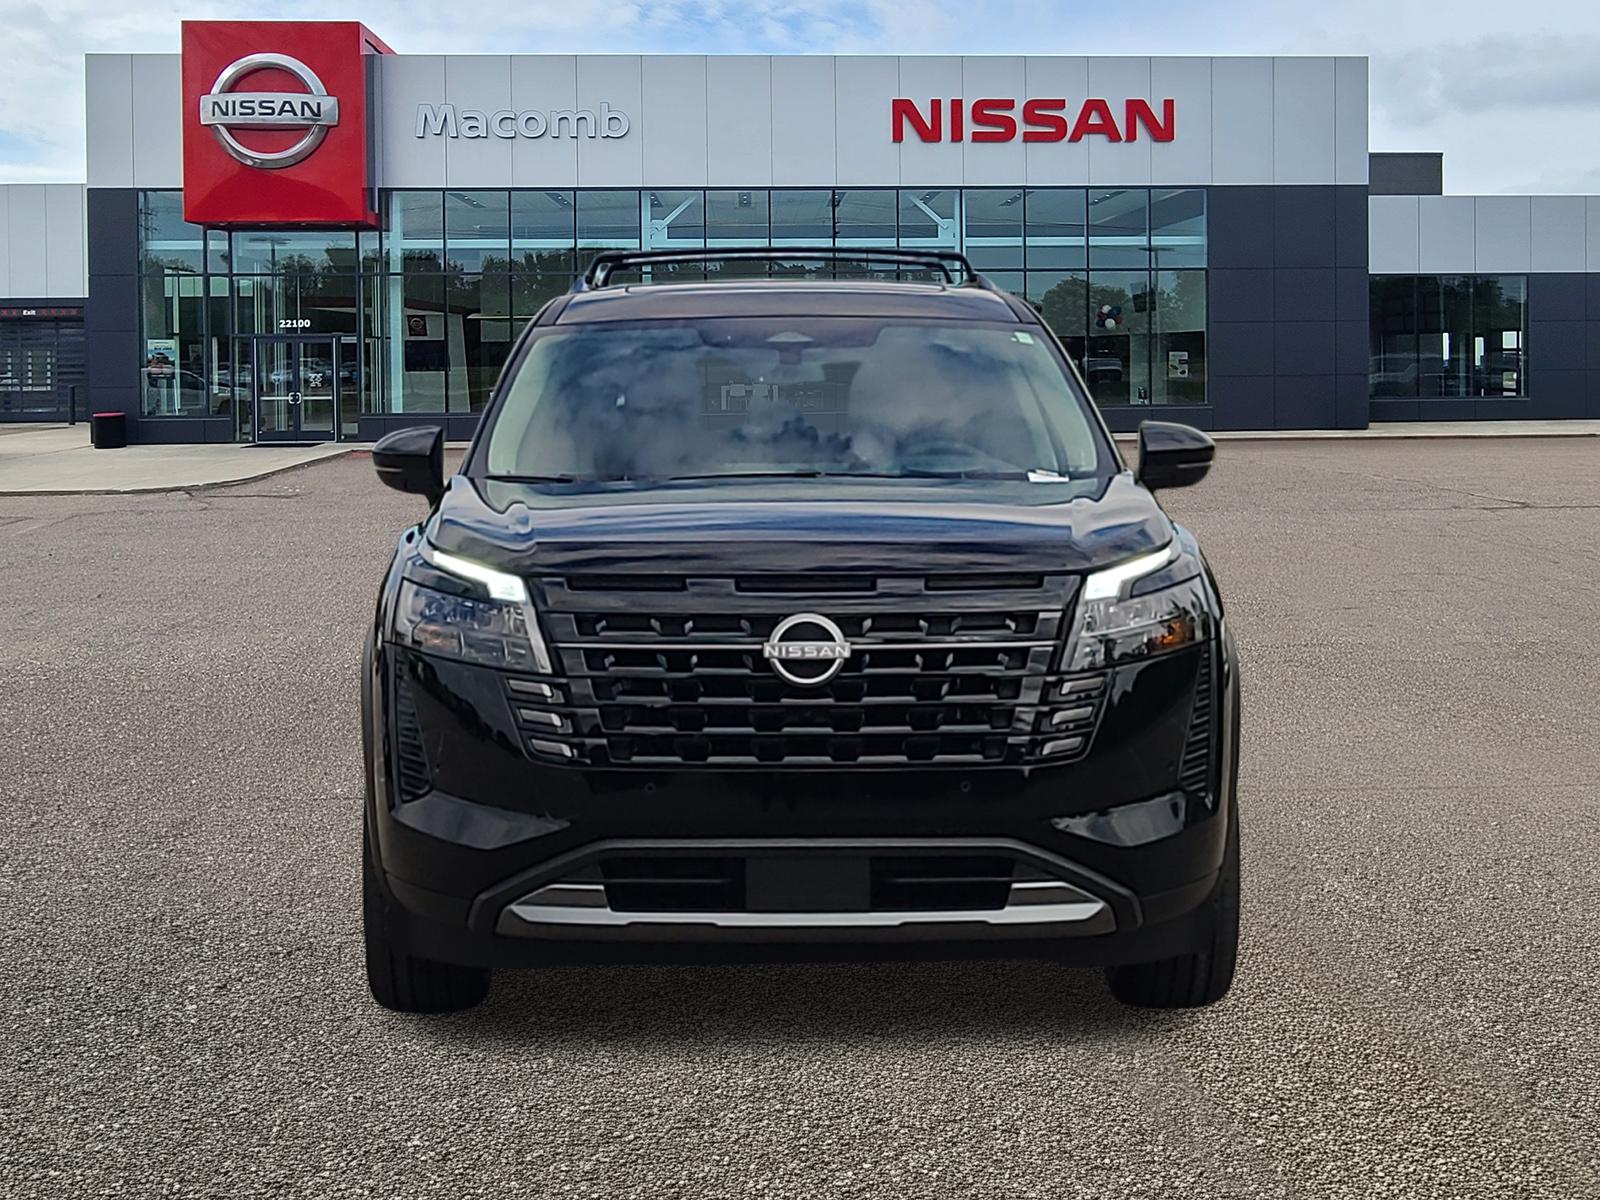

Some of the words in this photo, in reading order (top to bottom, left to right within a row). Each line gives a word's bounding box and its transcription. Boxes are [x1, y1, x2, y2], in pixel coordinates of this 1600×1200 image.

[212, 100, 321, 117] NISSAN
[415, 102, 630, 139] Macomb
[892, 98, 1176, 143] NISSAN
[279, 319, 311, 328] 22100
[765, 645, 848, 657] NISSAN
